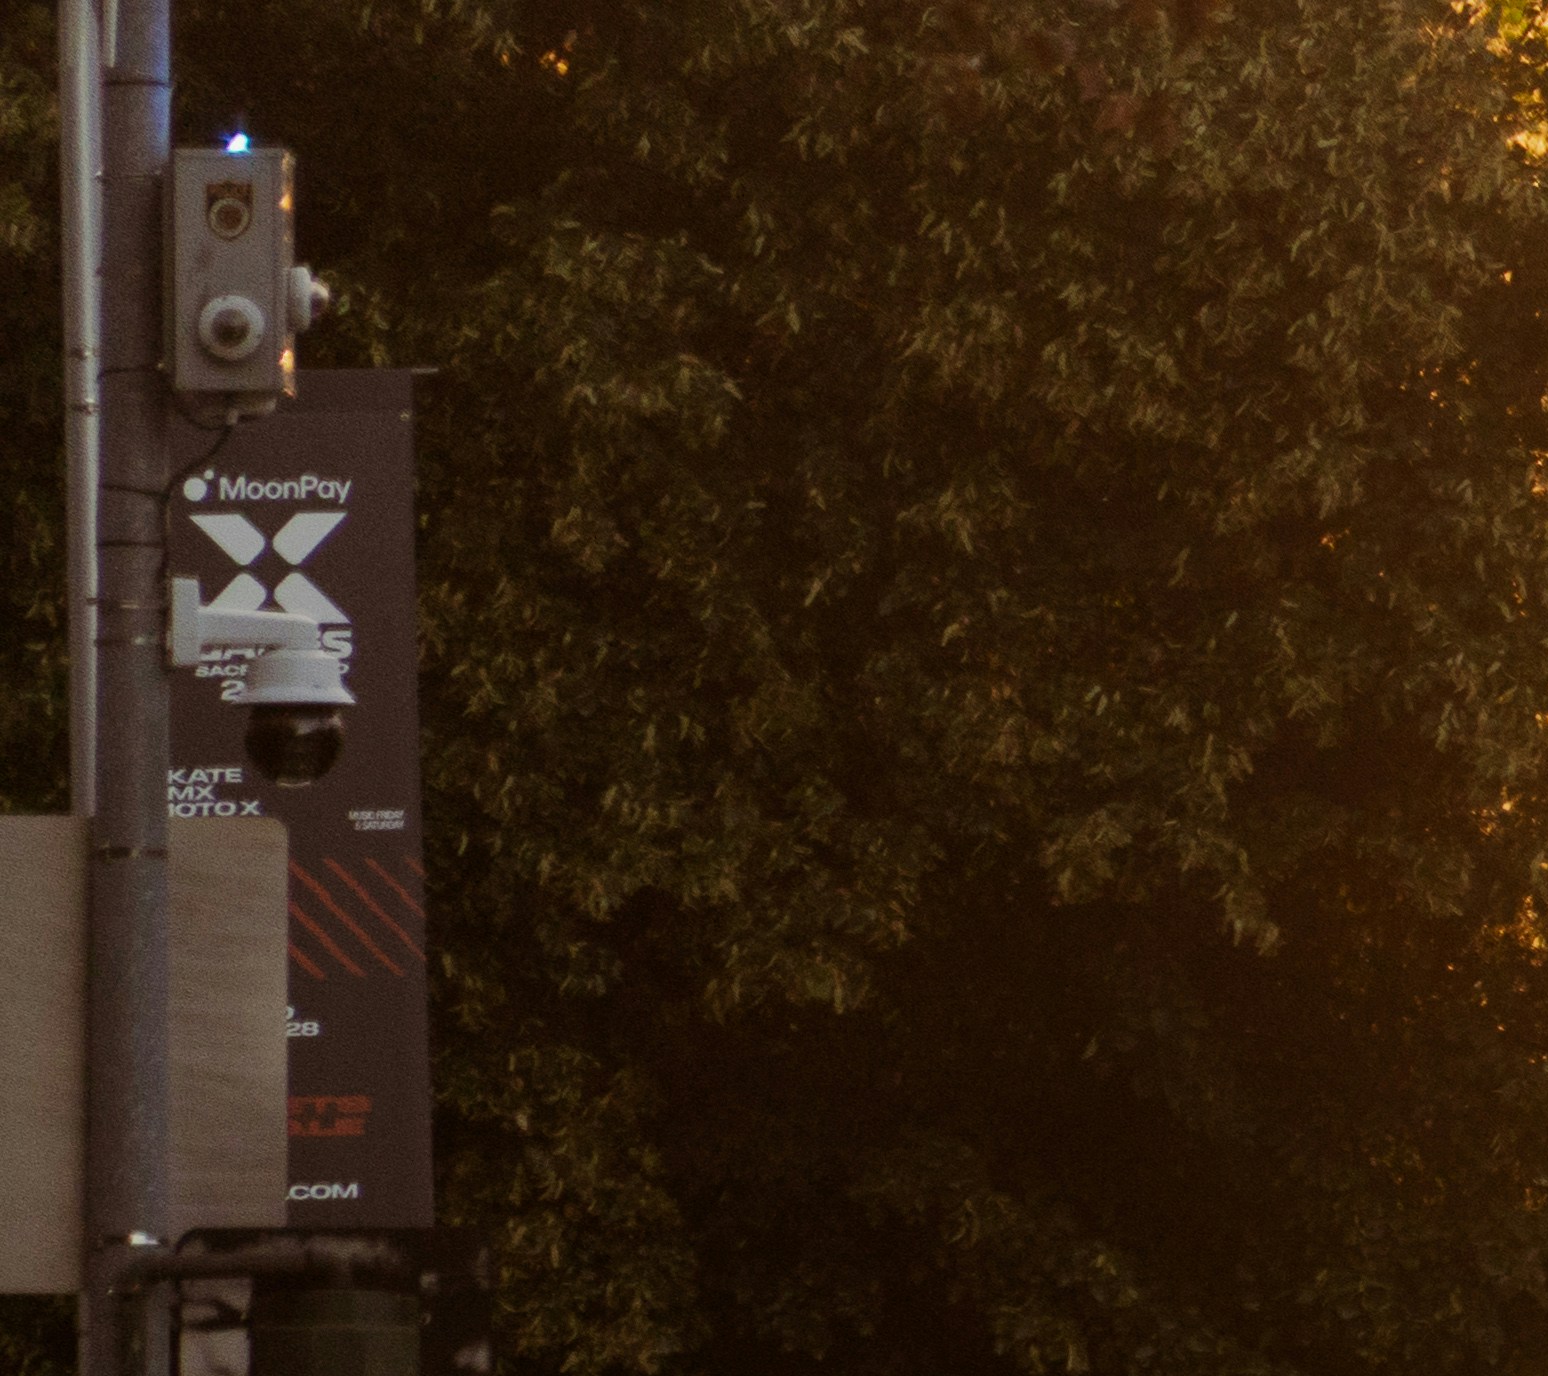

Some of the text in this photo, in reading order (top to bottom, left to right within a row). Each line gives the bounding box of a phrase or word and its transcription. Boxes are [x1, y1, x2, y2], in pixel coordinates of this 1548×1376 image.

[219, 475, 351, 504] MoonPay
[168, 768, 243, 783] KATE
[168, 786, 215, 800] MX
[240, 802, 260, 816] X
